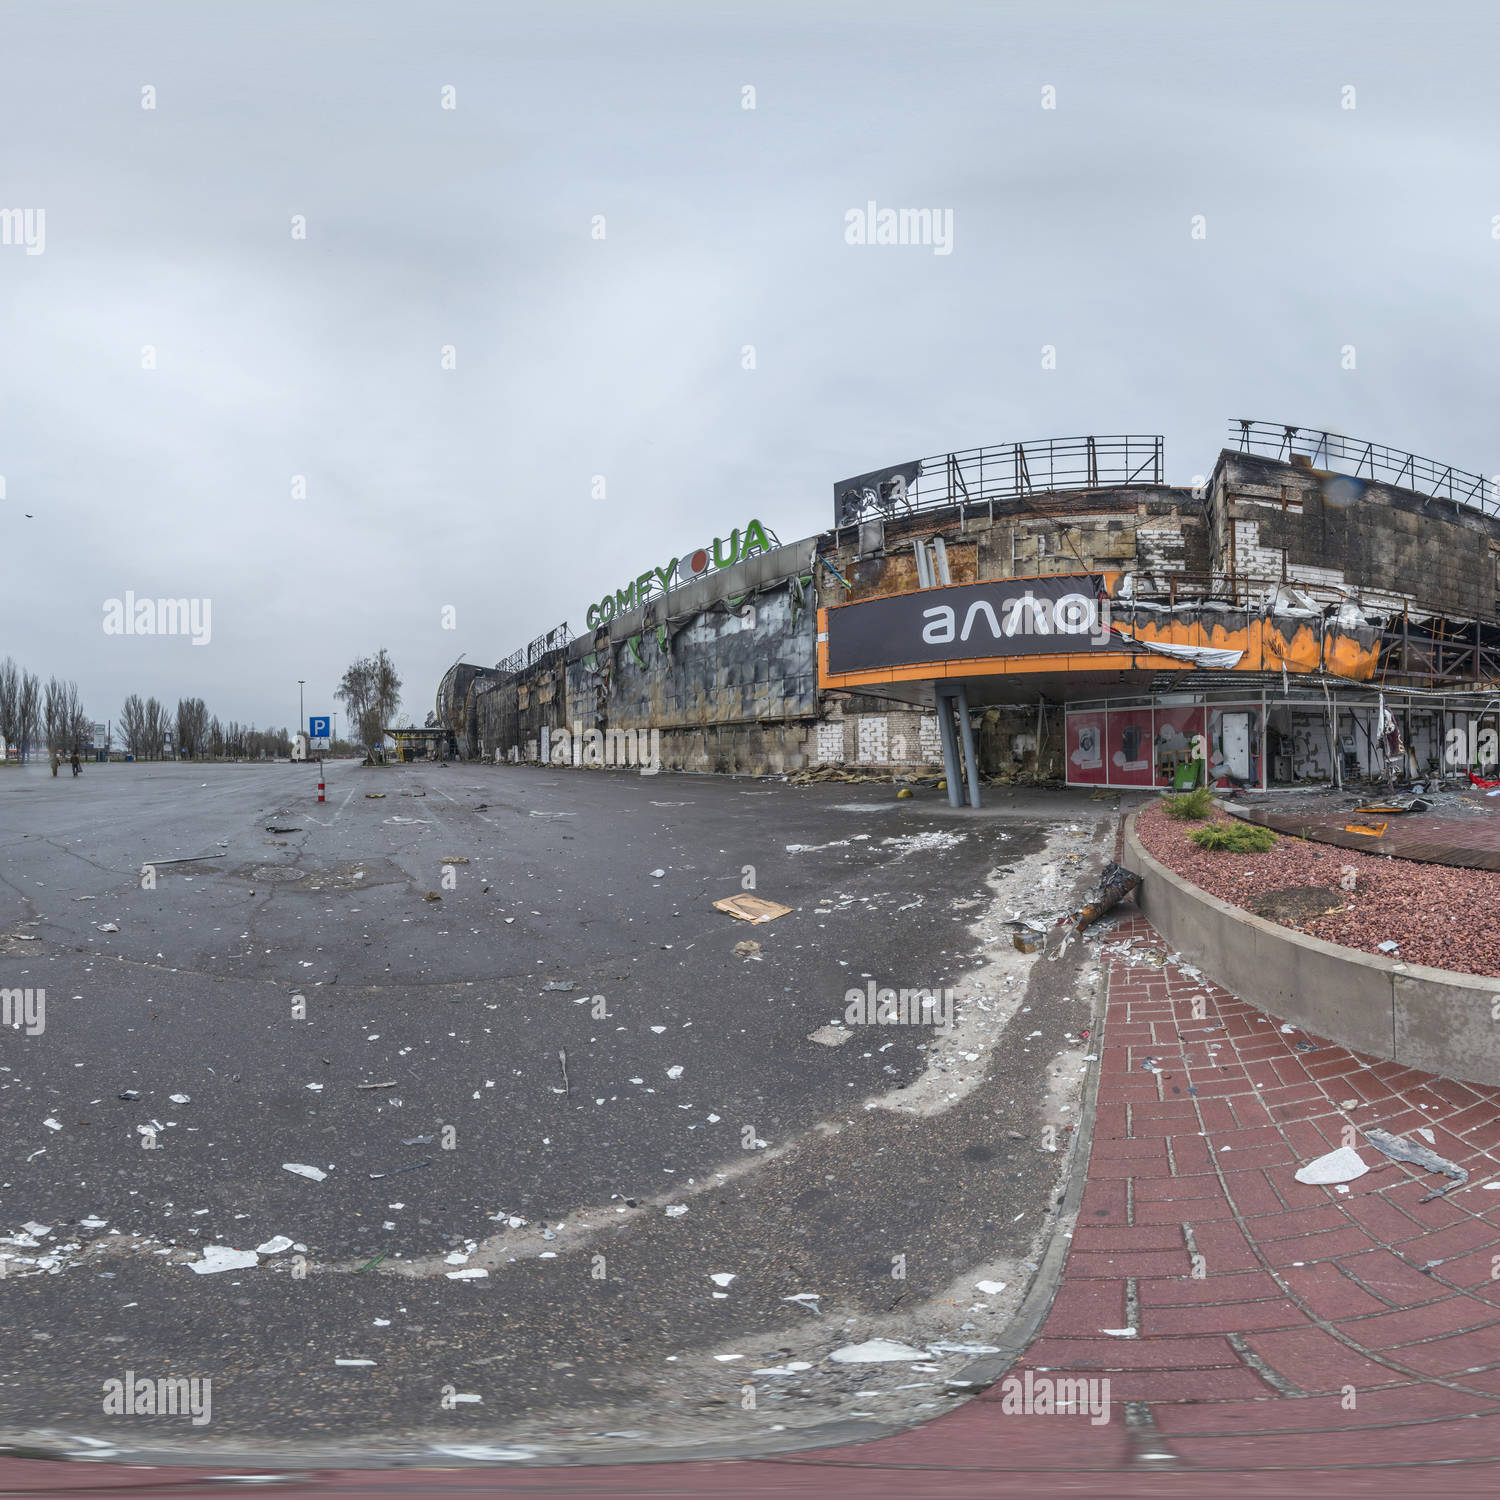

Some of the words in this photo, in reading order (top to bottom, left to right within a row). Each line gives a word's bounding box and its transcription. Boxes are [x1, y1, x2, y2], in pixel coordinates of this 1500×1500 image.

[586, 557, 679, 631] COMFY
[712, 518, 771, 569] UA
[315, 720, 325, 735] P
